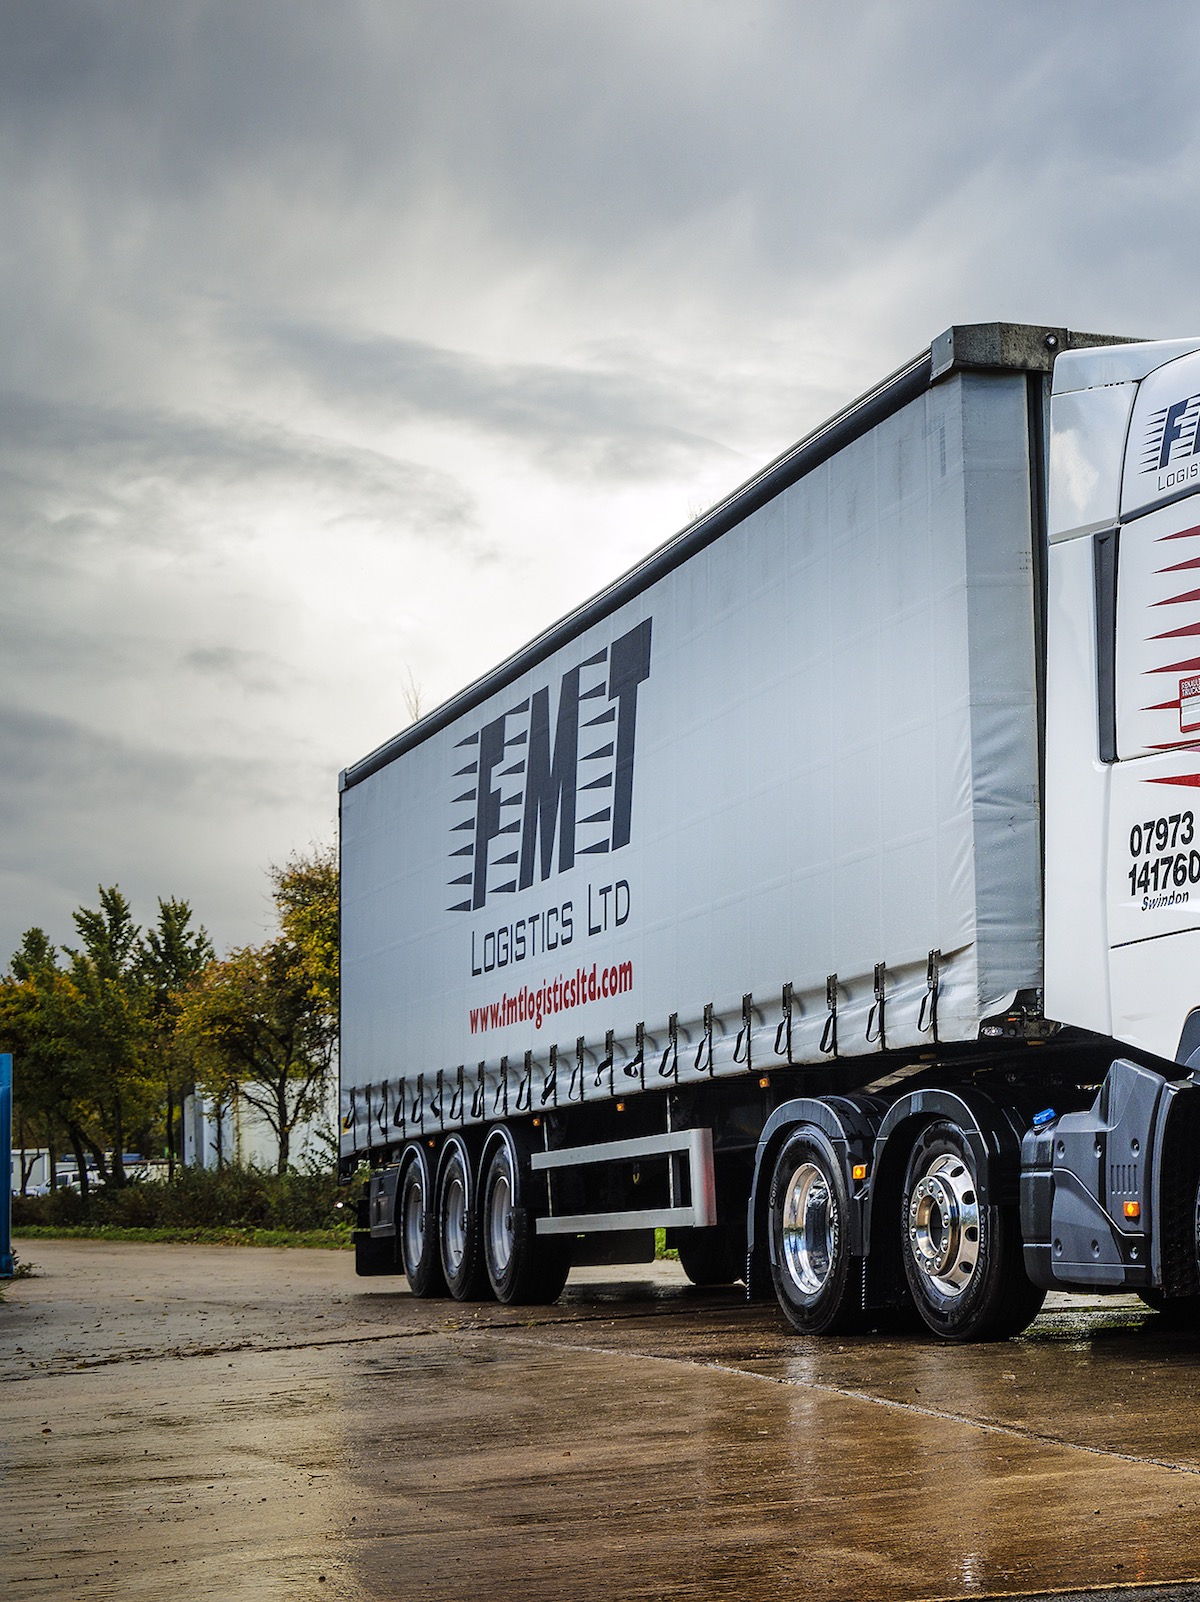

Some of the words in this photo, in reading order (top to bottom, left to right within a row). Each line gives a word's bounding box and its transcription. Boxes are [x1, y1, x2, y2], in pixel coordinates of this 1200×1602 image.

[472, 616, 653, 912] FMT
[1129, 810, 1195, 858] 07973
[1141, 888, 1190, 912] Swindon
[469, 958, 634, 1035] www.fmtlogisticsltd.com
